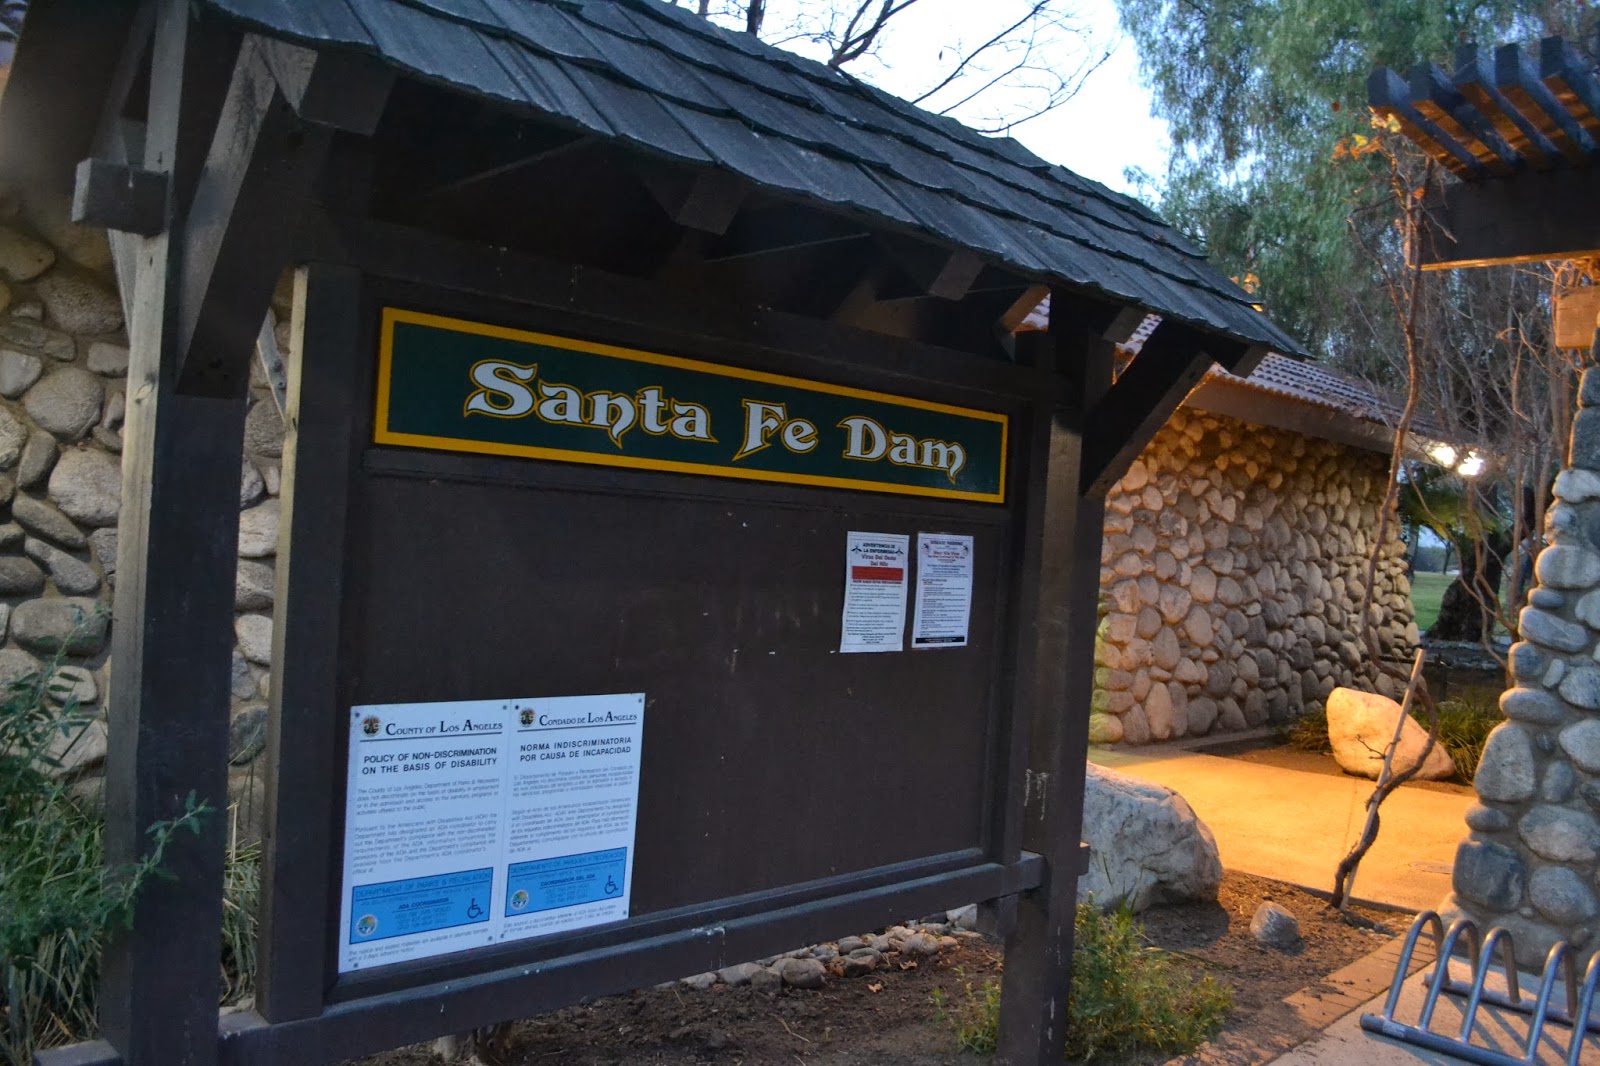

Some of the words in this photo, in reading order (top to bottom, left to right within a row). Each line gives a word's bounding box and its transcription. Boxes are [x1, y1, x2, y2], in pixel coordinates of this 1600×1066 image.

[464, 359, 719, 449] Santa
[732, 398, 819, 462] Fe
[836, 413, 967, 484] Dam
[520, 743, 550, 752] NORMA
[553, 736, 632, 749] INDISCRIMINATORIA
[364, 754, 395, 764] POLICY
[398, 753, 410, 761] OF
[412, 747, 497, 760] NON-DISCRIMINATION
[520, 754, 537, 762] POR
[540, 751, 566, 761] CAUSA
[569, 750, 579, 758] DE
[583, 746, 631, 757] INCAPACIDAD
[362, 766, 376, 775] ON
[381, 765, 399, 773] THE
[403, 763, 430, 772] BASIS
[435, 761, 447, 769] OF
[451, 758, 498, 769] DISABILITY
